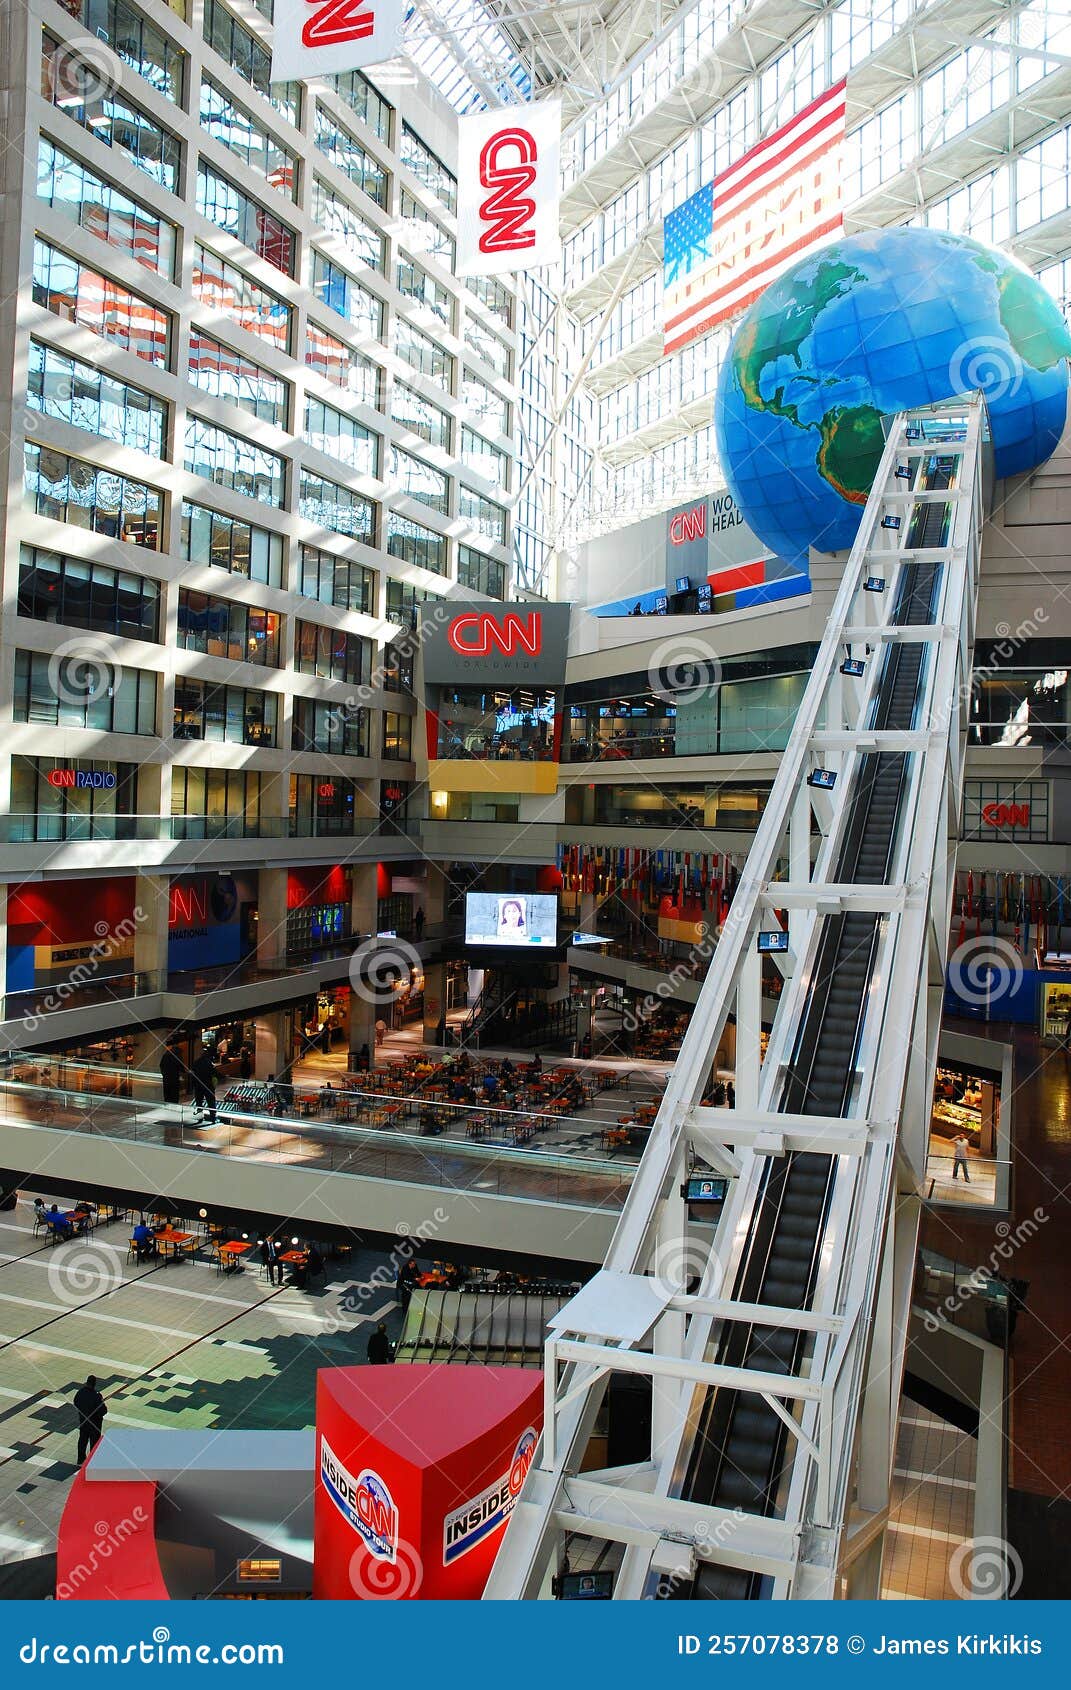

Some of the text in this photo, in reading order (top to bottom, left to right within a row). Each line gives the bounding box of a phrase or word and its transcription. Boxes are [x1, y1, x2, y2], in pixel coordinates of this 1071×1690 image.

[479, 127, 537, 253] CNN
[670, 504, 706, 546] CNN
[712, 495, 737, 515] WO
[448, 612, 541, 656] CNN
[47, 769, 117, 789] CNN RADIO
[982, 802, 1029, 829] CNN
[168, 880, 208, 928] NN
[322, 1448, 357, 1511] INSIDE
[356, 1484, 395, 1547] CNN
[446, 1483, 509, 1545] INSIDE
[349, 1510, 392, 1555] STUDIO TOUR
